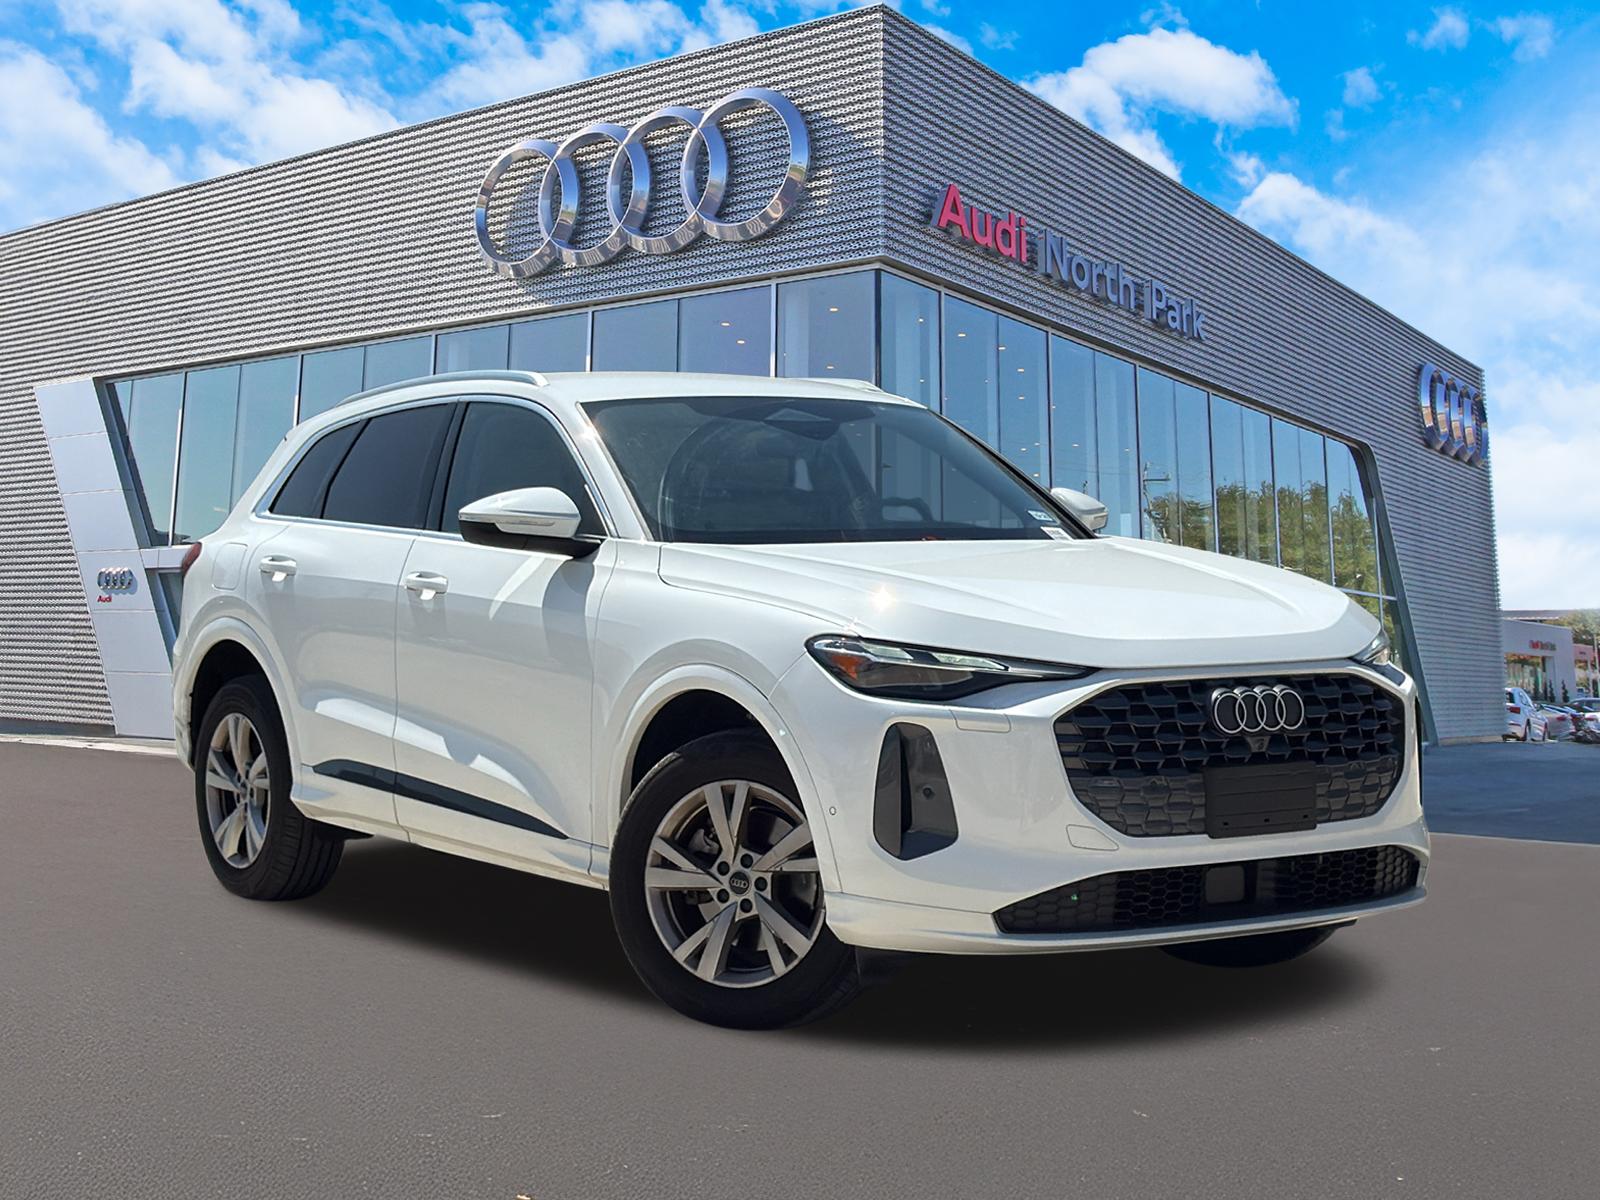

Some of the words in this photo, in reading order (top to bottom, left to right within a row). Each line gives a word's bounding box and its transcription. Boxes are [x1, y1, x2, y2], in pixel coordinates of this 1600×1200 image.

[932, 183, 1028, 263] Audi
[1038, 229, 1137, 312] North
[1144, 278, 1208, 341] Park
